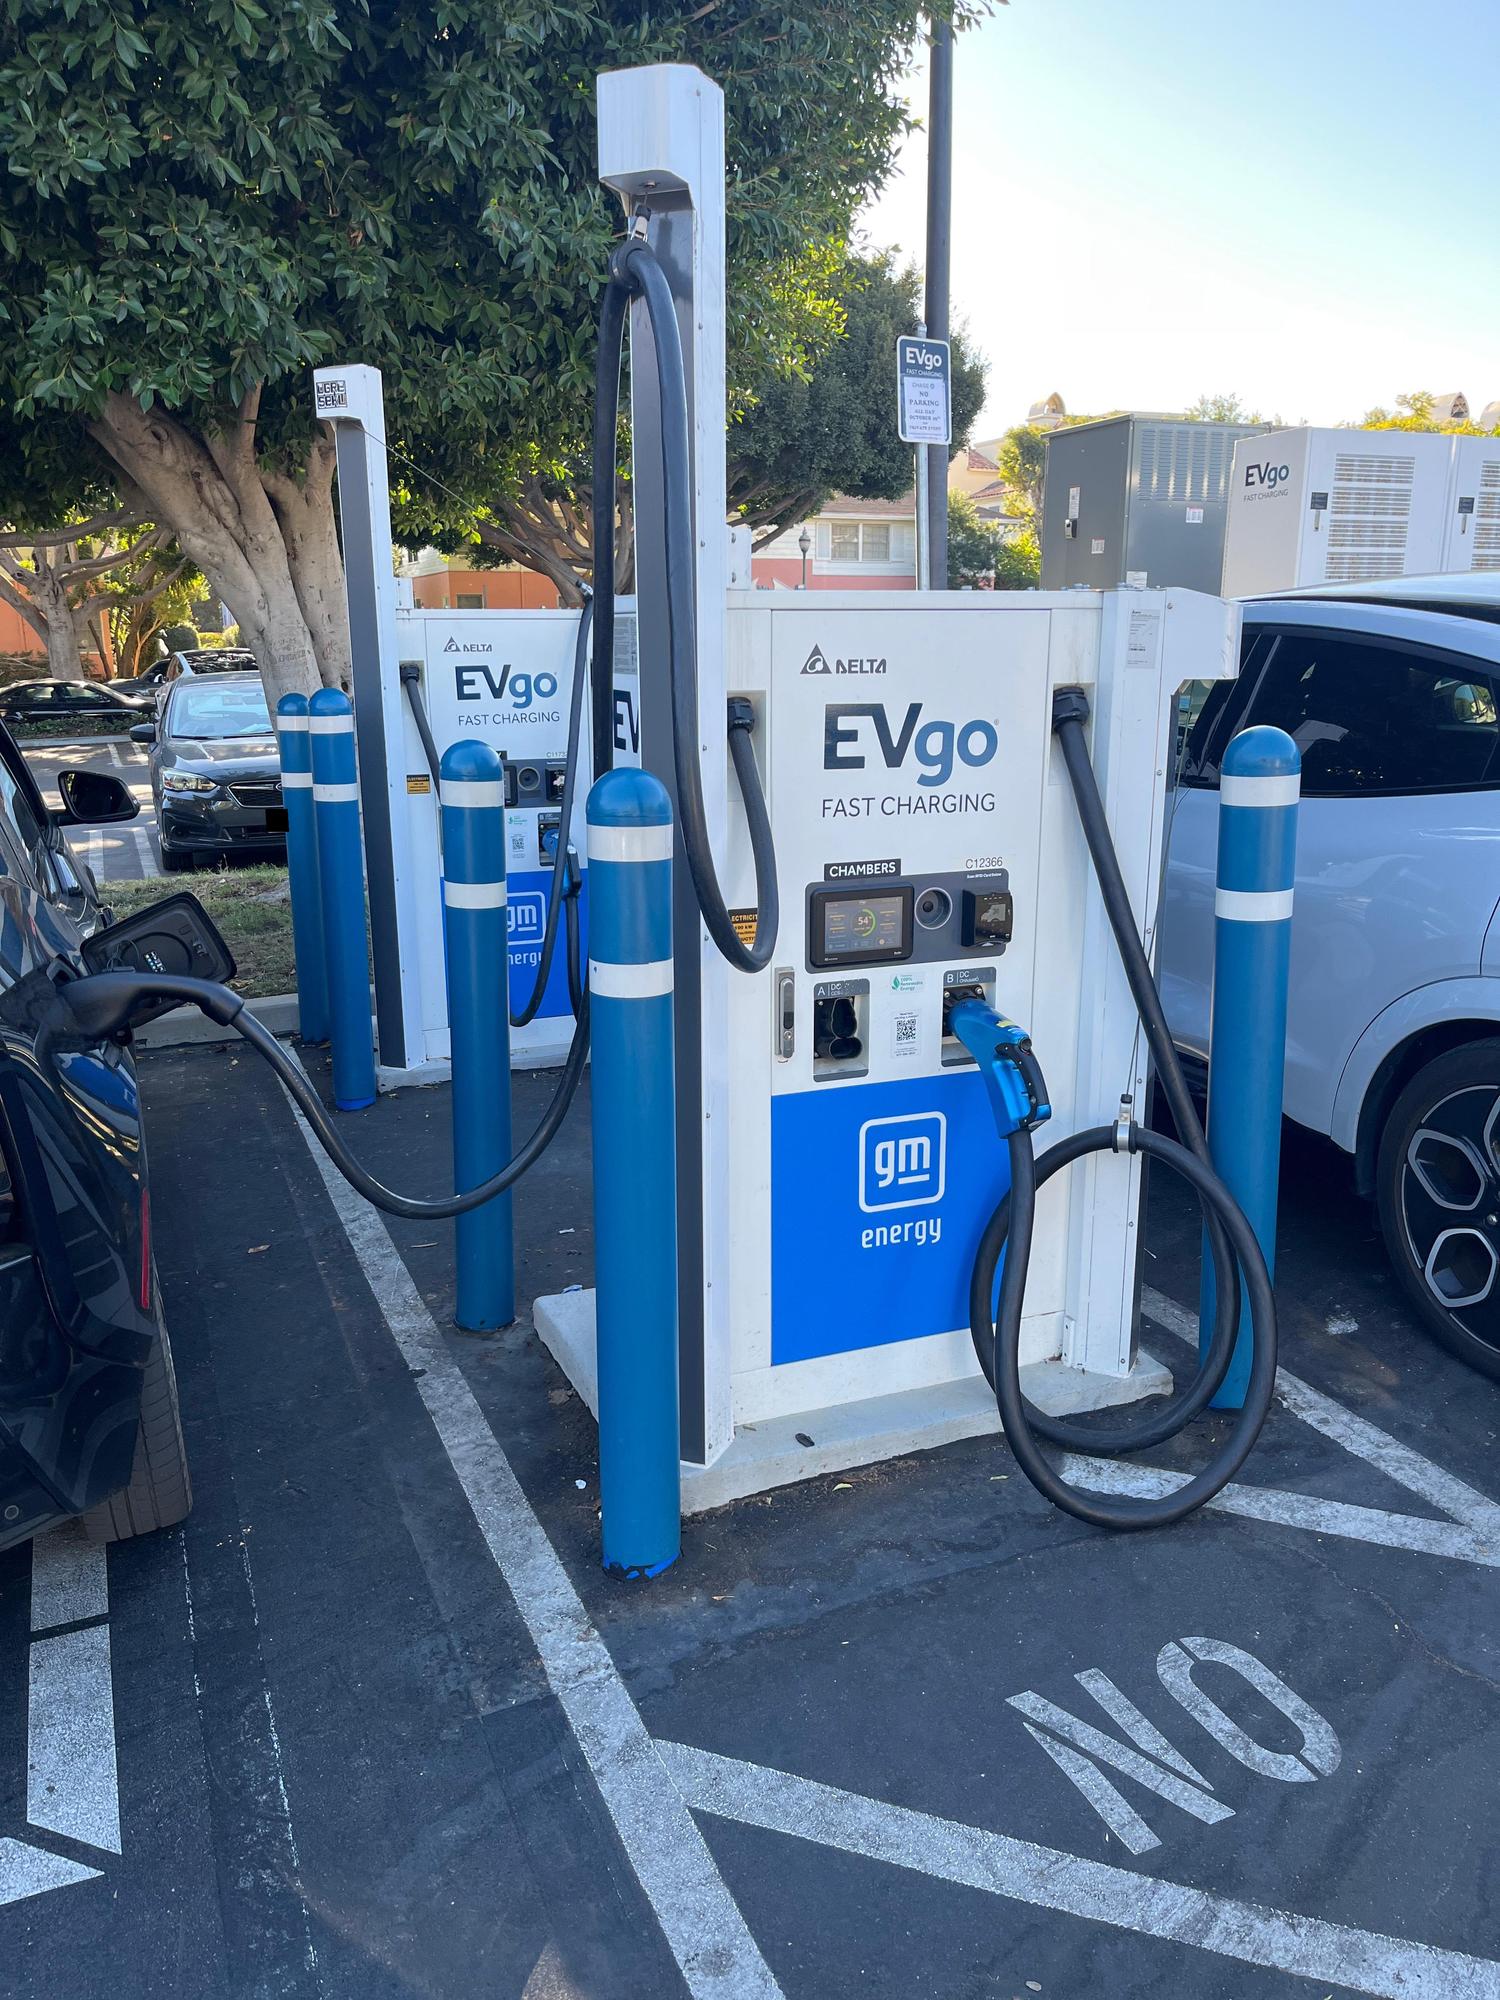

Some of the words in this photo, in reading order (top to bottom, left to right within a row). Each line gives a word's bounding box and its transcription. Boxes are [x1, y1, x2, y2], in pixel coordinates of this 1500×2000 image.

[906, 347, 942, 370] EVgo
[918, 369, 944, 377] CHARGING
[909, 398, 940, 407] PARKING
[1244, 461, 1290, 489] EVgo
[1243, 493, 1260, 503] FAST
[1258, 488, 1289, 501] CHARGING
[463, 643, 493, 653] DELTA
[835, 658, 887, 674] DELTA
[455, 664, 558, 709] EVgo
[458, 714, 489, 727] FAST
[492, 711, 560, 725] CHARGING
[613, 689, 640, 754] EV
[823, 702, 999, 788] EVgo
[822, 797, 875, 818] FAST
[881, 793, 995, 816] CHARGING
[829, 862, 896, 877] CHAMBERS
[965, 857, 1003, 869] C12366
[732, 914, 758, 922] ECTRICIT
[507, 951, 542, 967] nerg
[946, 973, 954, 983] B
[959, 970, 970, 978] DC
[817, 986, 826, 996] A
[831, 983, 842, 991] DC
[875, 1136, 931, 1188] gm
[861, 1217, 942, 1249] energy
[1005, 1636, 1343, 1856] NO
